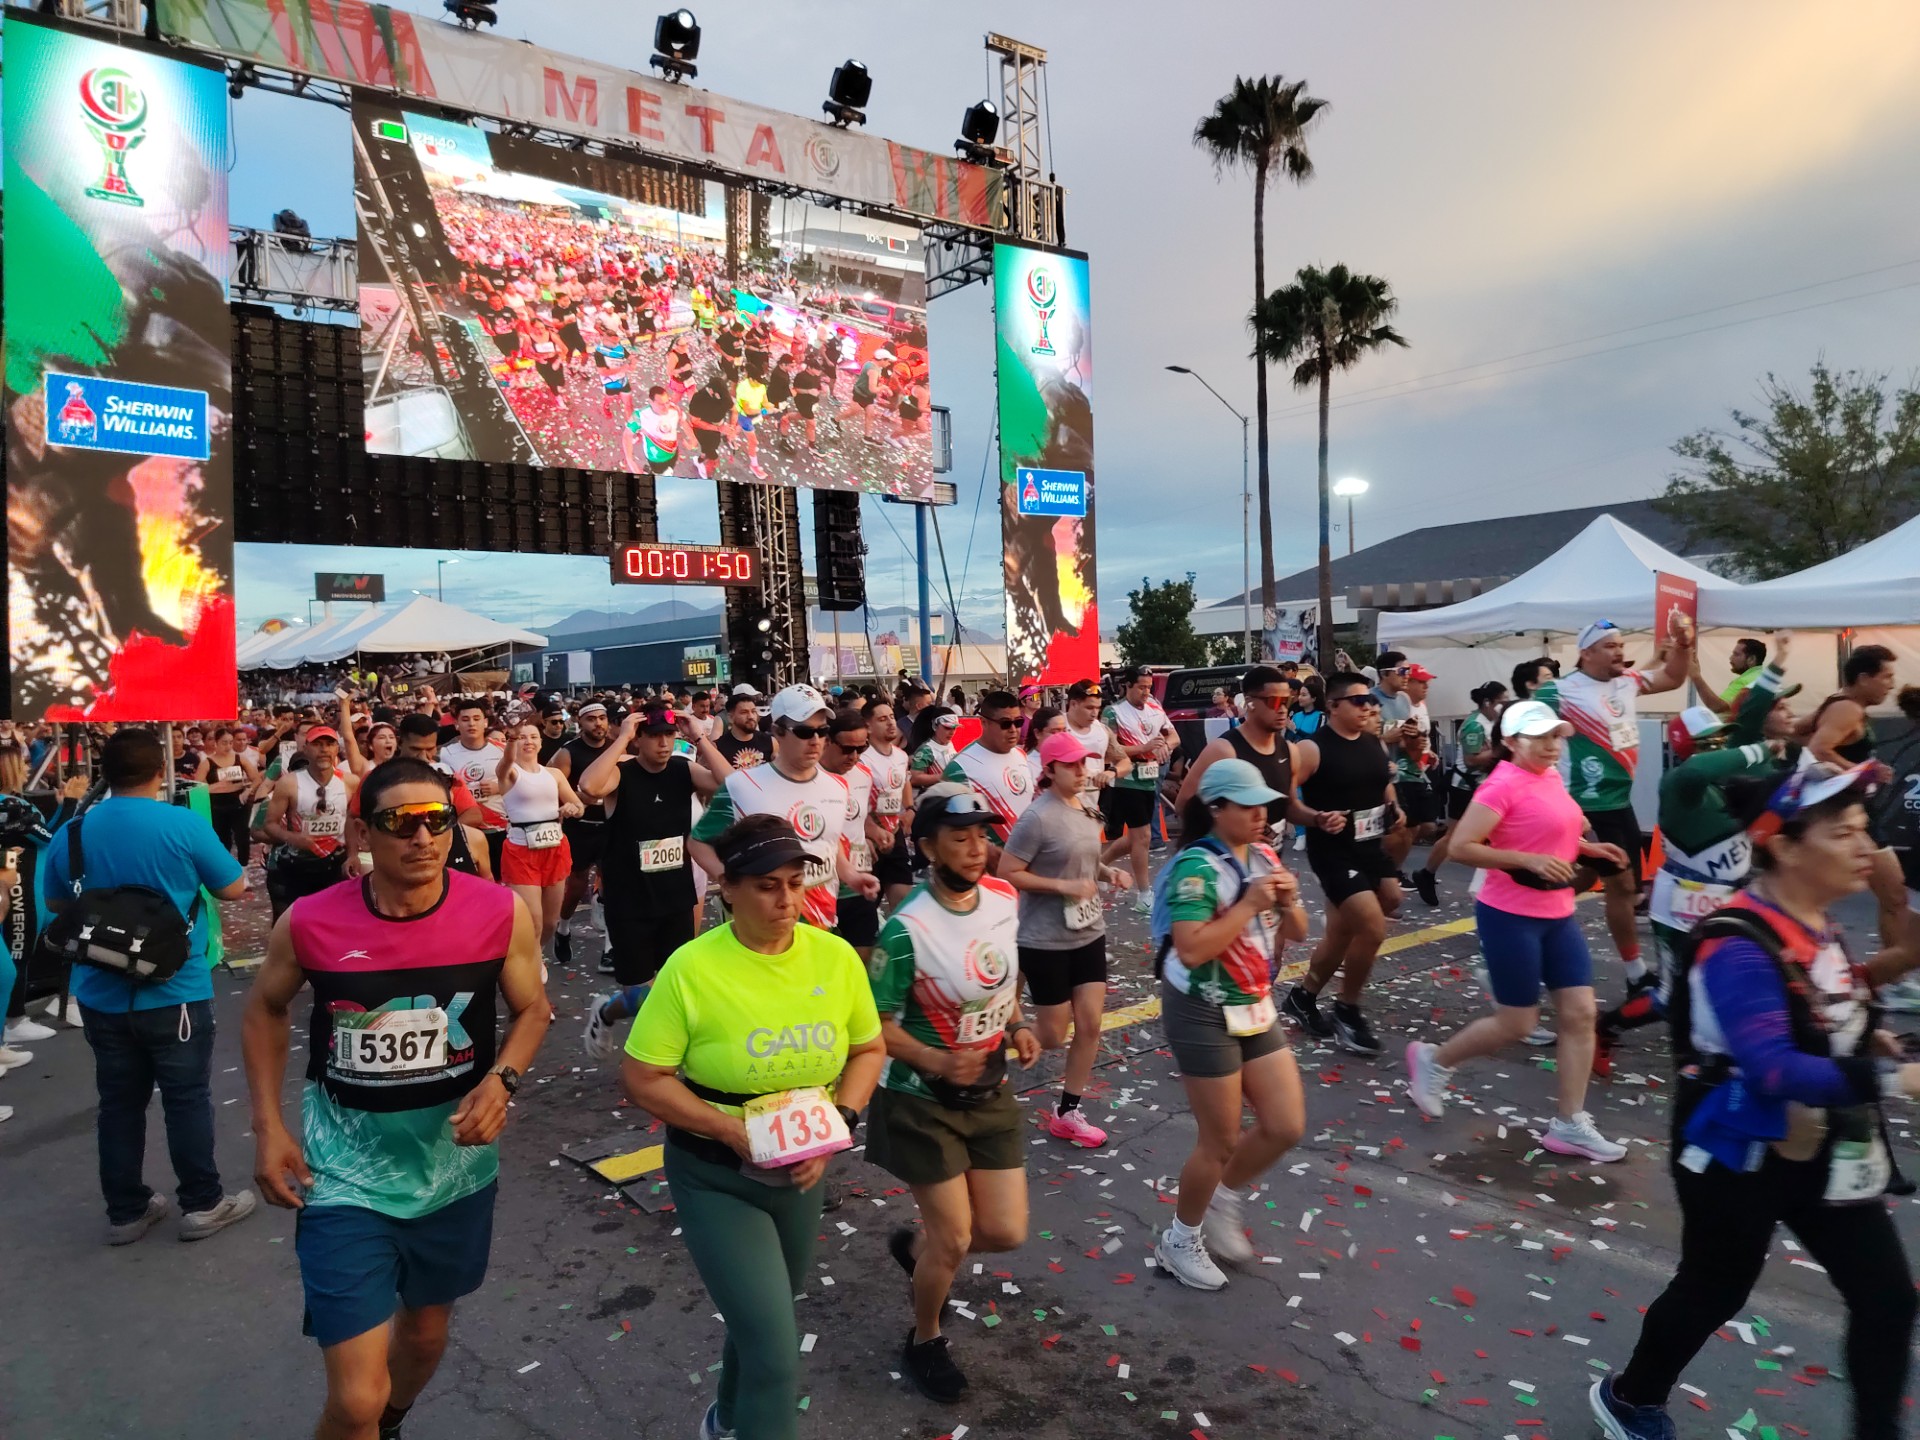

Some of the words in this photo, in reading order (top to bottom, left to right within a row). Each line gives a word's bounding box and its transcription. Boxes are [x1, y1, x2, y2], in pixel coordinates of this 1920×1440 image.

[543, 66, 786, 174] META
[104, 395, 194, 422] SHERWIN
[1041, 479, 1080, 493] SHERWIN
[626, 549, 751, 580] 00:01:50
[687, 662, 711, 676] ELITE
[310, 821, 339, 833] 2252
[535, 829, 560, 843] 4433
[652, 846, 682, 865] 2060
[360, 1028, 439, 1065] 5367
[768, 1106, 833, 1152] 133
